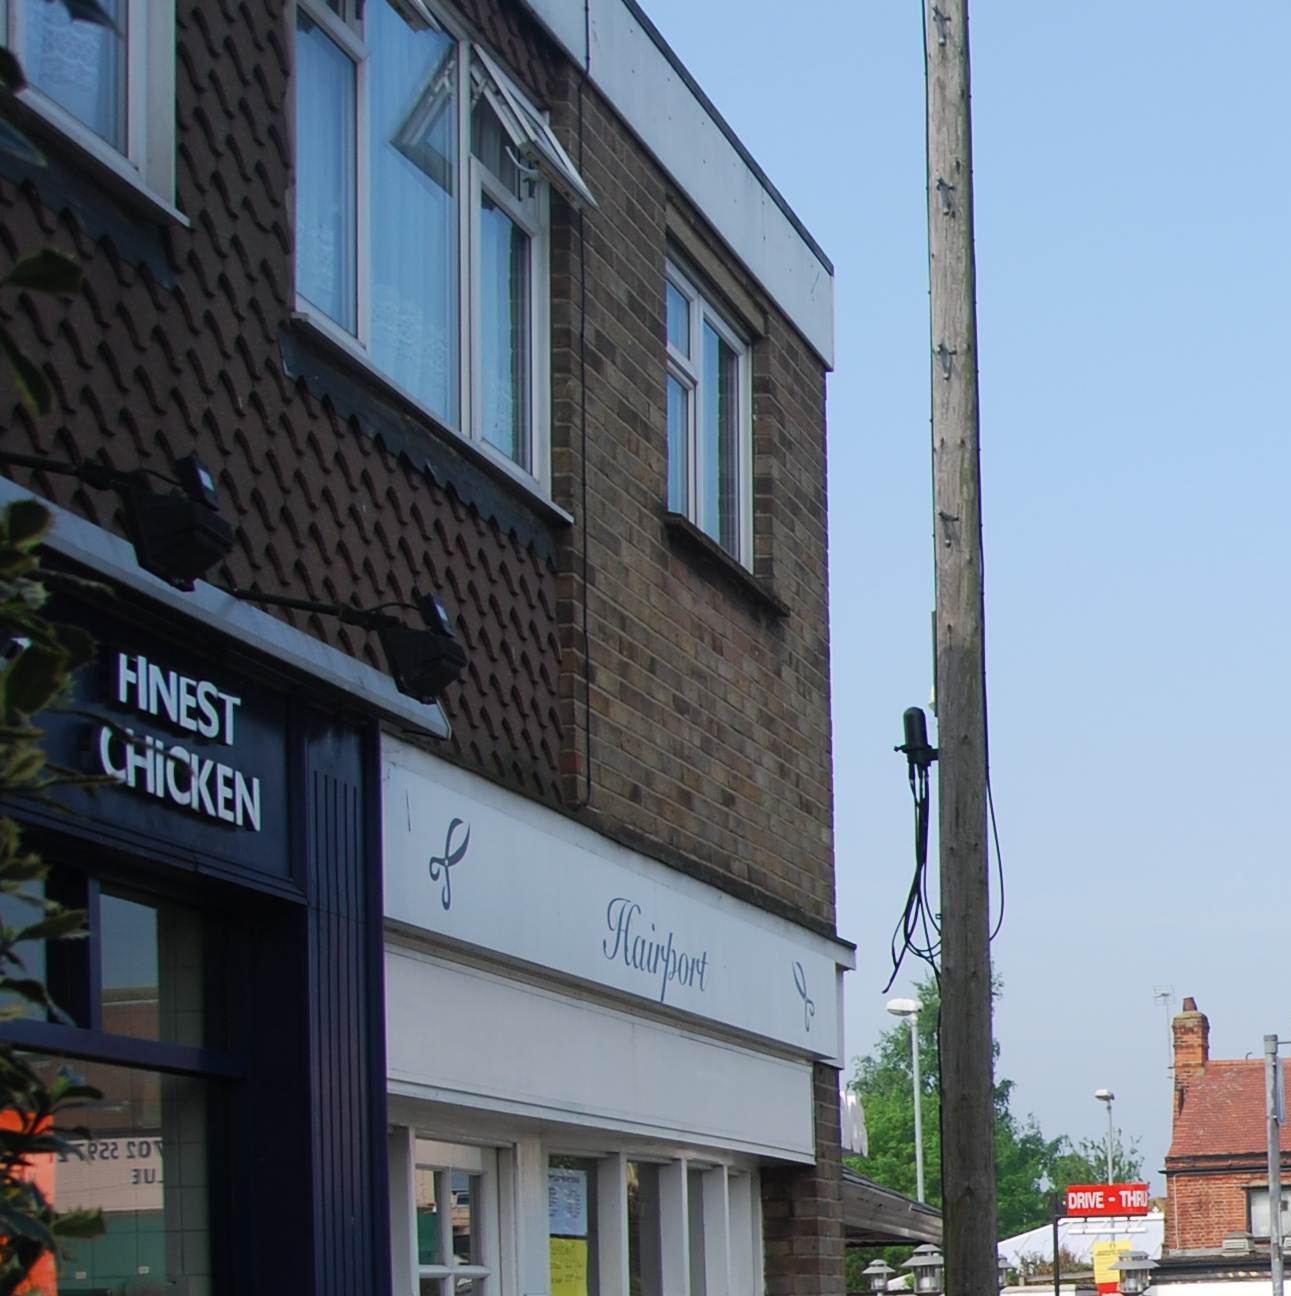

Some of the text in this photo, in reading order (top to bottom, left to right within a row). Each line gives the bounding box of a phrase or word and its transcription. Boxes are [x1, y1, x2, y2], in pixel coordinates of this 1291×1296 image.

[100, 725, 261, 832] CHICKEN
[602, 897, 708, 1003] Hairport
[1068, 1191, 1105, 1209] DRIVE
[1119, 1190, 1148, 1207] THRU
